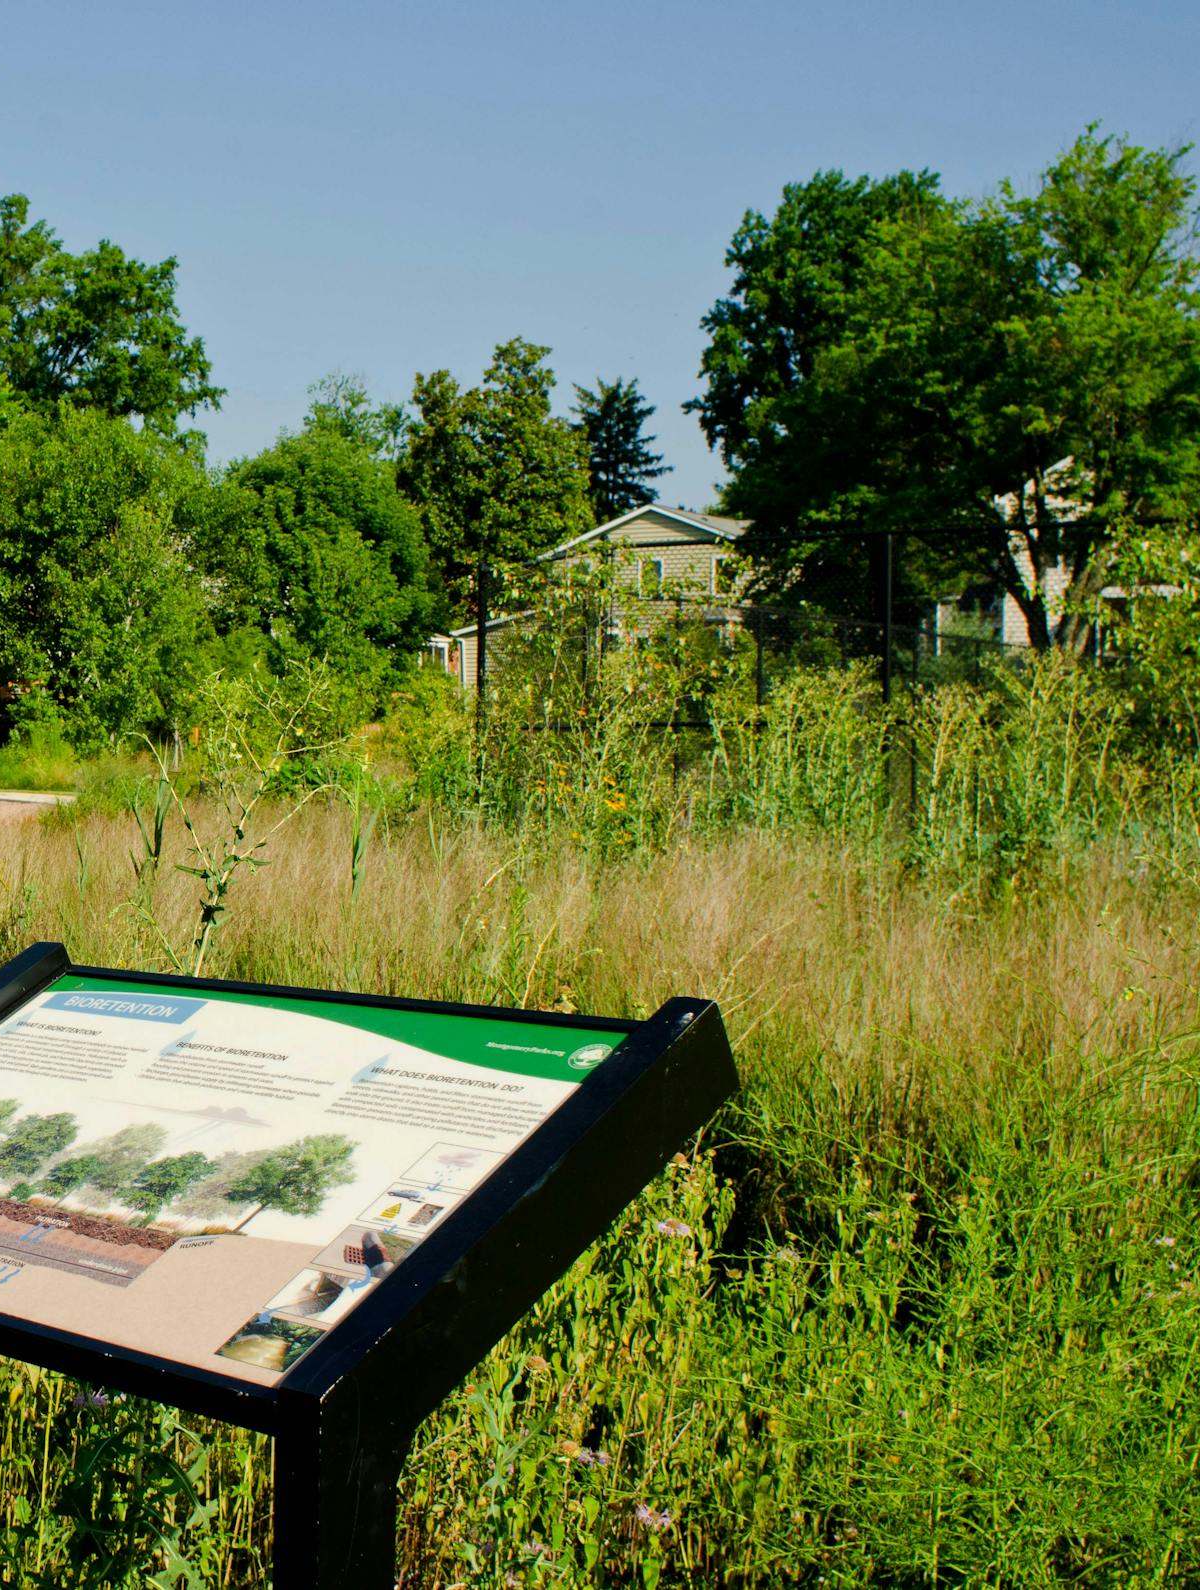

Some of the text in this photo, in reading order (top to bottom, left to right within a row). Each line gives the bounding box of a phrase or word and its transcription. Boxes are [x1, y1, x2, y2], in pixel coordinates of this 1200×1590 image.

[65, 996, 178, 1017] BIORETENTION
[176, 1042, 215, 1051] BENEFITS
[225, 1048, 289, 1061] BIORETENTION
[370, 1067, 524, 1093] WHAT DOES BIORETENTION DO?
[179, 1240, 214, 1248] RUNOFF
